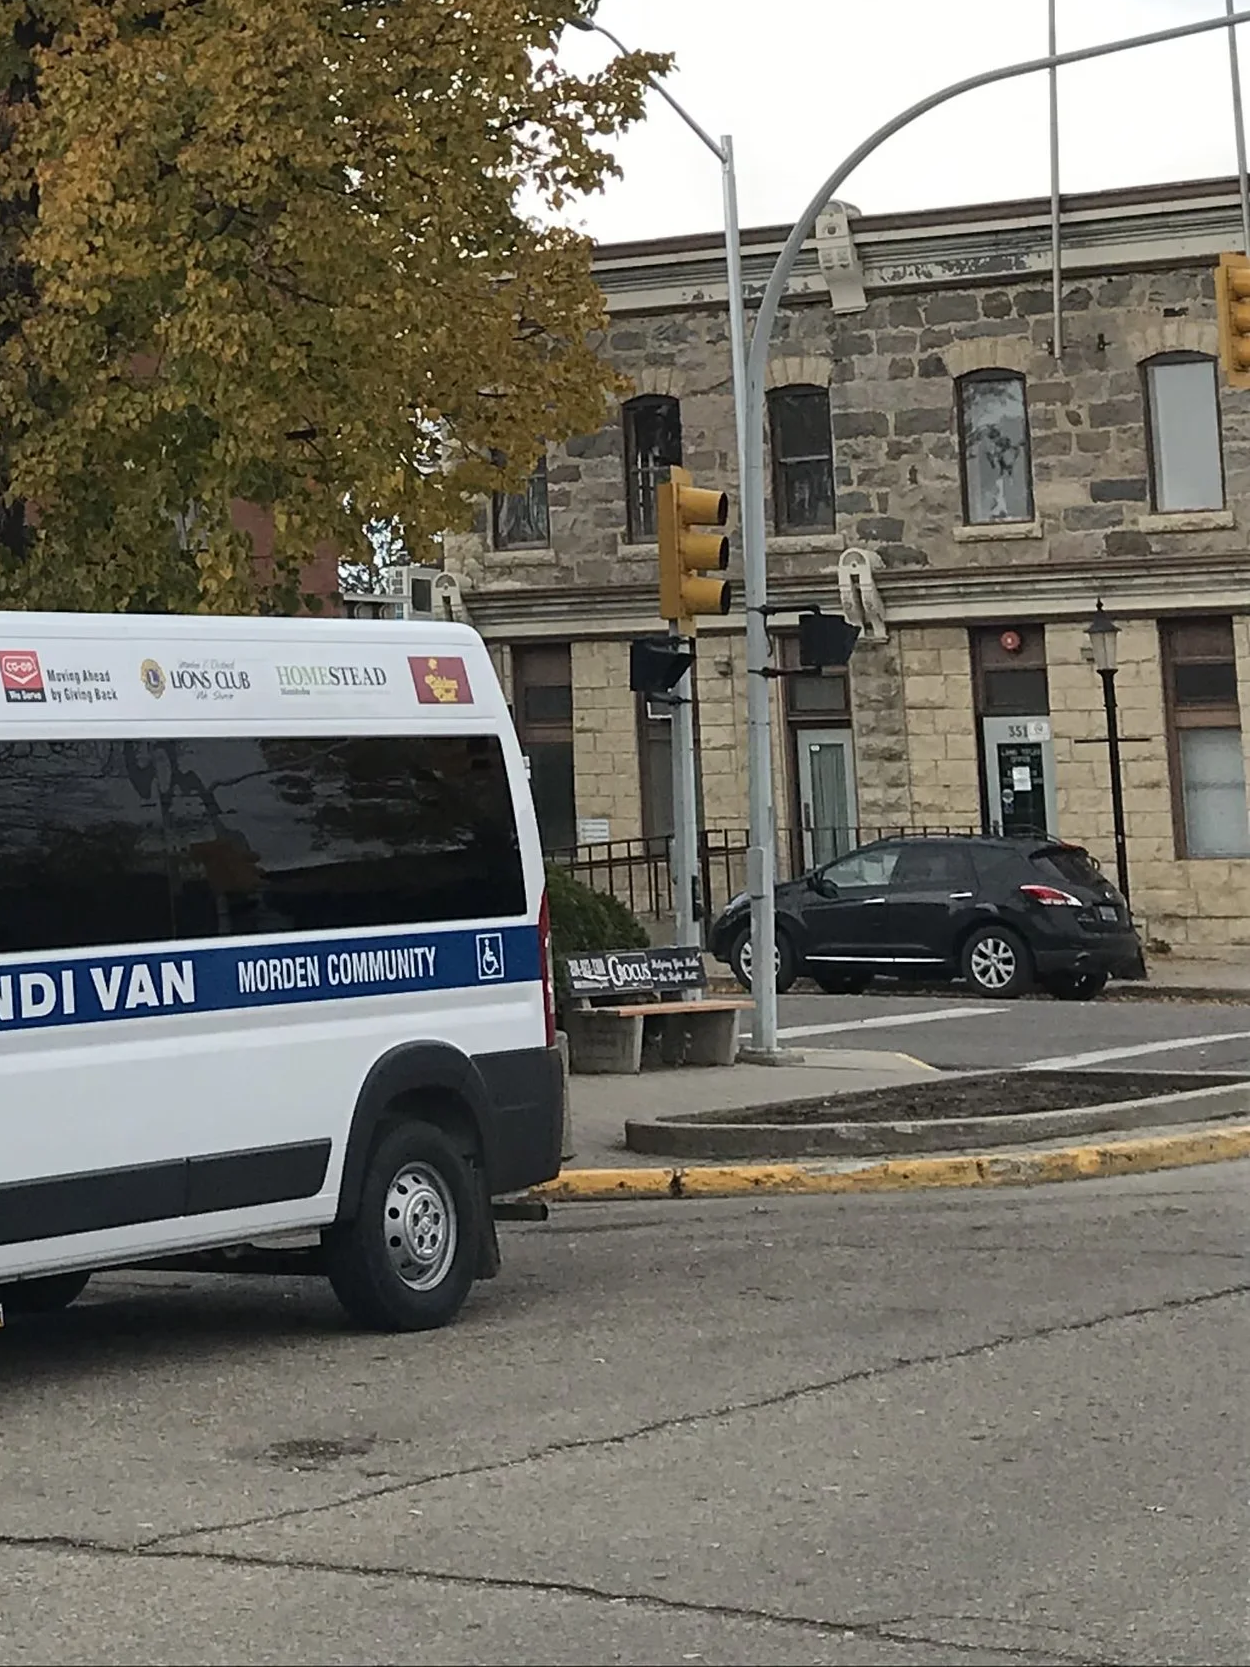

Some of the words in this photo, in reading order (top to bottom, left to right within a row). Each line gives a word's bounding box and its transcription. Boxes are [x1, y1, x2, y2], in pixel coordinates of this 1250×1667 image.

[47, 669, 81, 685] Moving
[82, 669, 111, 682] Ahead
[170, 669, 212, 690] LIONS
[214, 670, 251, 690] CLUB
[275, 665, 387, 686] HOMESTEAD
[51, 688, 62, 703] by
[64, 688, 92, 704] Giving
[94, 688, 118, 701] Back
[90, 959, 197, 1012] VAN
[237, 954, 320, 994] MORDEN
[327, 947, 437, 986] COMMUNITY
